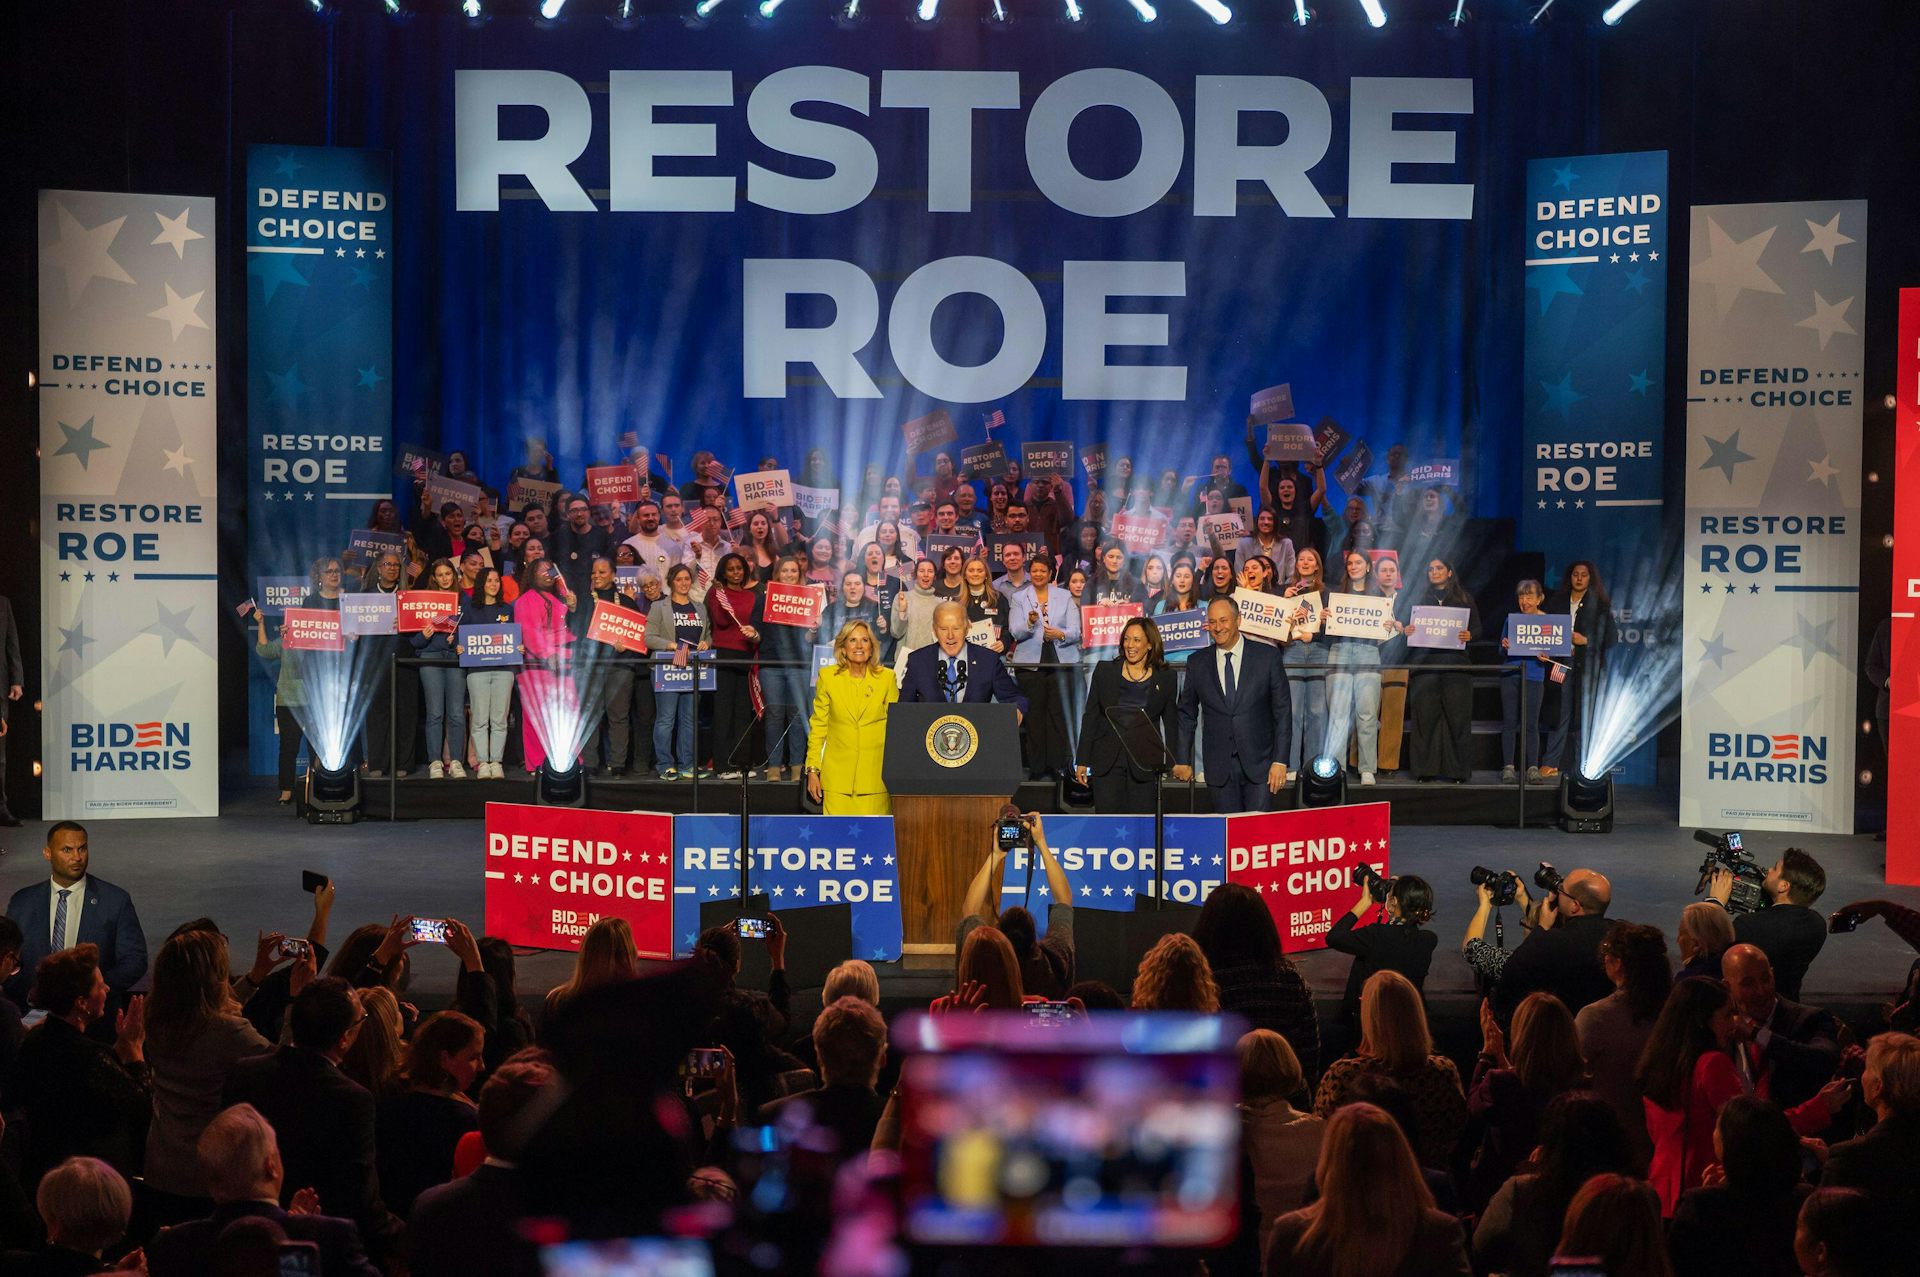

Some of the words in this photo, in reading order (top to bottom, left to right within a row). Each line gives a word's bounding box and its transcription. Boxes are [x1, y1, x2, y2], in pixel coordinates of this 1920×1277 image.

[455, 65, 1474, 219] RESTORE
[258, 188, 387, 212] DEFEND
[1537, 194, 1661, 221] DEFEND
[258, 217, 377, 241] CHOICE
[1535, 224, 1651, 251] CHOICE
[743, 255, 1187, 403] ROE
[52, 354, 163, 373] DEFEND
[1700, 367, 1809, 385] DEFEND
[104, 379, 206, 398] CHOICE
[1750, 390, 1852, 407] CHOICE
[263, 434, 383, 453] RESTORE
[1271, 434, 1315, 442] RESTORE
[1028, 451, 1068, 460] DEFED
[1536, 441, 1653, 460] RESTORE
[963, 451, 1001, 465] RESTORE
[1030, 460, 1067, 468] CHOICE
[264, 458, 348, 484] ROE
[973, 461, 992, 471] ROE
[1411, 464, 1452, 475] BIDEN
[594, 476, 633, 485] DEFEND
[1410, 471, 1452, 481] HARRIS
[1537, 466, 1618, 491] ROE
[596, 484, 632, 494] CHOICE
[744, 479, 783, 492] BIDEN
[745, 488, 785, 500] HARRIS
[795, 492, 832, 503] BIDEN
[57, 503, 203, 524] RESTORE
[1118, 524, 1160, 536] DEFEND
[1700, 516, 1847, 535] RESTORE
[1118, 533, 1156, 544] CHOICE
[58, 533, 160, 562] ROE
[353, 540, 403, 553] RESTORE
[1700, 544, 1802, 574] ROE
[265, 586, 311, 597] BIDEN
[266, 597, 304, 606] HARRI
[402, 602, 452, 611] RESTORE
[772, 593, 815, 606] DEFEND
[345, 605, 393, 614] RESTORE
[772, 604, 811, 617] CHOICE
[1241, 600, 1285, 619] BIDEN
[1335, 606, 1383, 617] DEFEND
[291, 620, 340, 631] DEFEND
[358, 615, 380, 623] ROE
[600, 612, 645, 633] DEFEND
[1158, 620, 1202, 632] DEFEND
[1239, 611, 1283, 628] HARRIS
[1336, 616, 1380, 627] CHOICE
[1414, 617, 1463, 628] RESTORE
[293, 630, 337, 641] CHOICE
[599, 622, 642, 641] CHOICE
[1425, 627, 1448, 637] ROE
[1516, 624, 1563, 636] BIDEN
[467, 634, 514, 646] BIDEN
[1516, 635, 1563, 645] HARRIS
[467, 645, 514, 655] HARRIS
[664, 671, 707, 681] CHOIE
[71, 721, 190, 748] BIDEN
[1708, 733, 1828, 761] BIDEN
[71, 750, 191, 772] HARRIS
[1708, 761, 1828, 784] HARRIS
[489, 833, 618, 866] DEFEND
[1231, 837, 1345, 872] DEFEND
[684, 847, 856, 870] RESTORE
[549, 869, 665, 901] CHOICE
[819, 880, 893, 902] ROE
[552, 909, 600, 926] BIDEN
[1290, 908, 1331, 926] BIDEN
[552, 923, 590, 937] HARR
[1290, 922, 1332, 938] HARRIS
